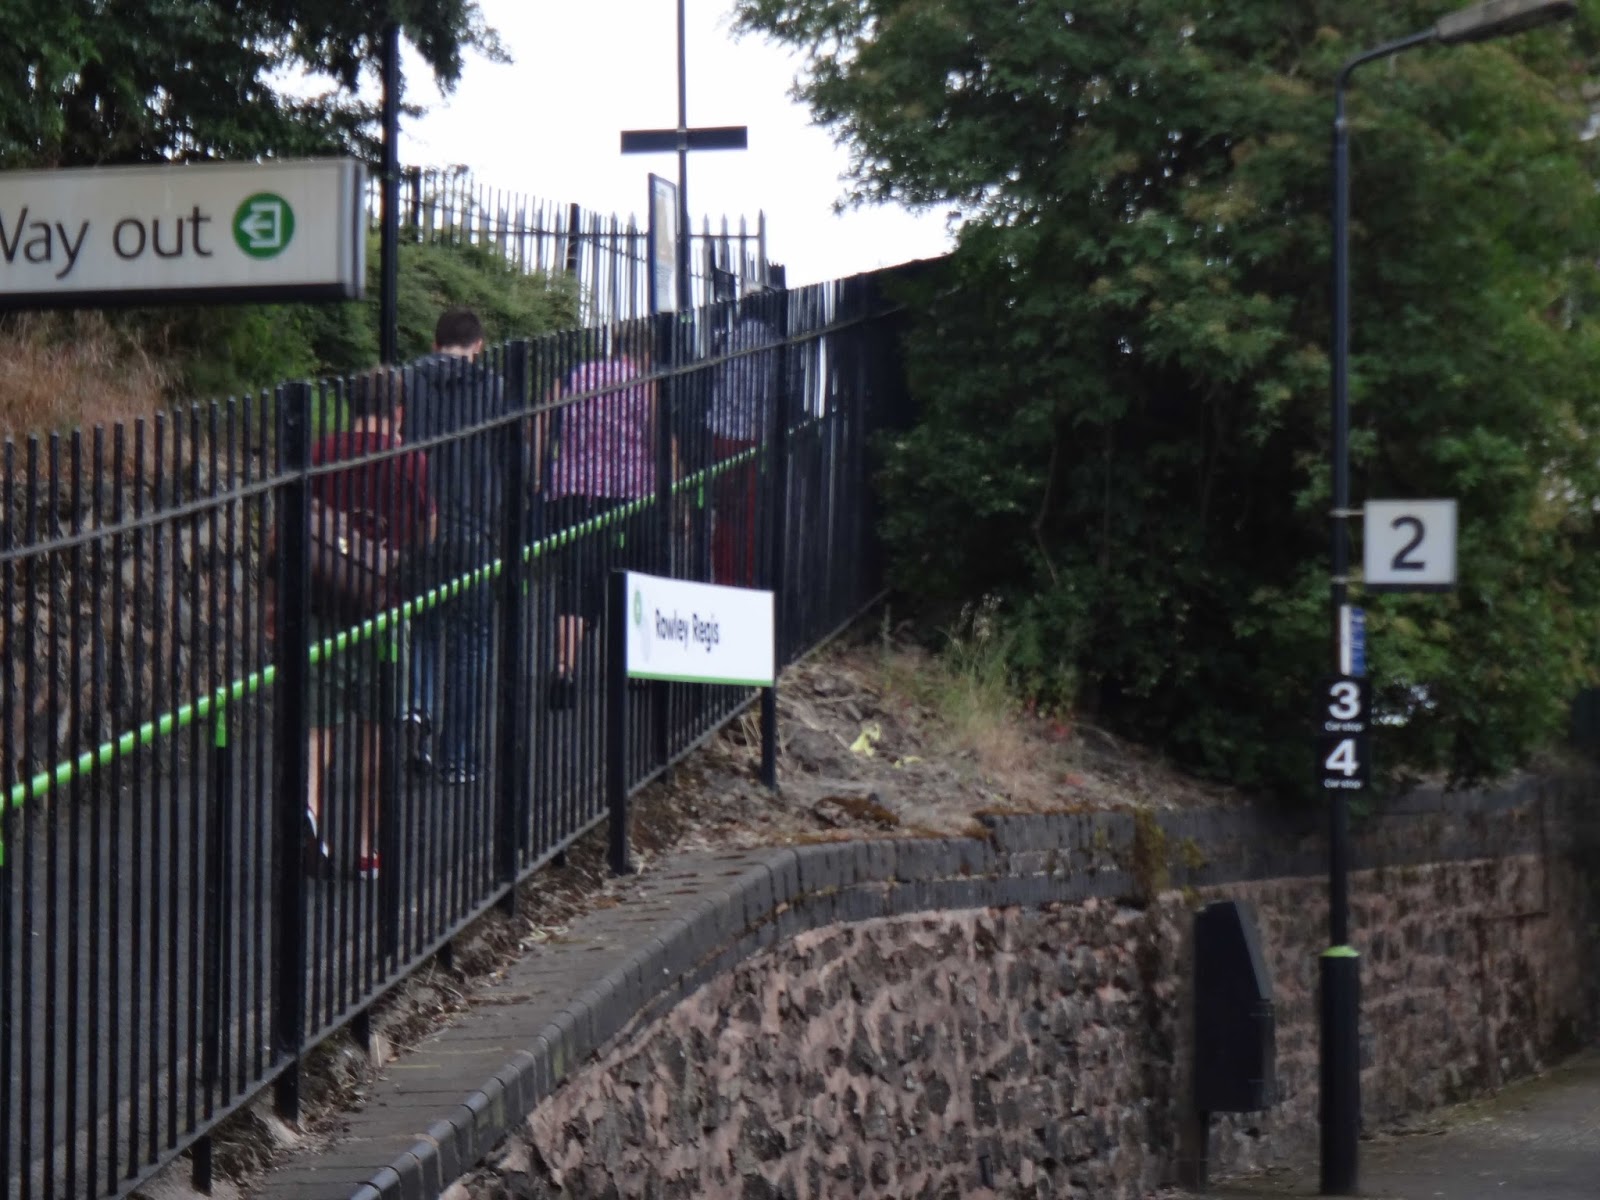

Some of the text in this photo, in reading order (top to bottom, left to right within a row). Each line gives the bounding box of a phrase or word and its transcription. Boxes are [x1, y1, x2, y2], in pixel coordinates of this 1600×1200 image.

[112, 204, 213, 260] out
[1390, 515, 1426, 571] 2
[655, 608, 719, 653] Rowley Regis
[1328, 681, 1361, 720] 3
[1325, 739, 1361, 776] 4
